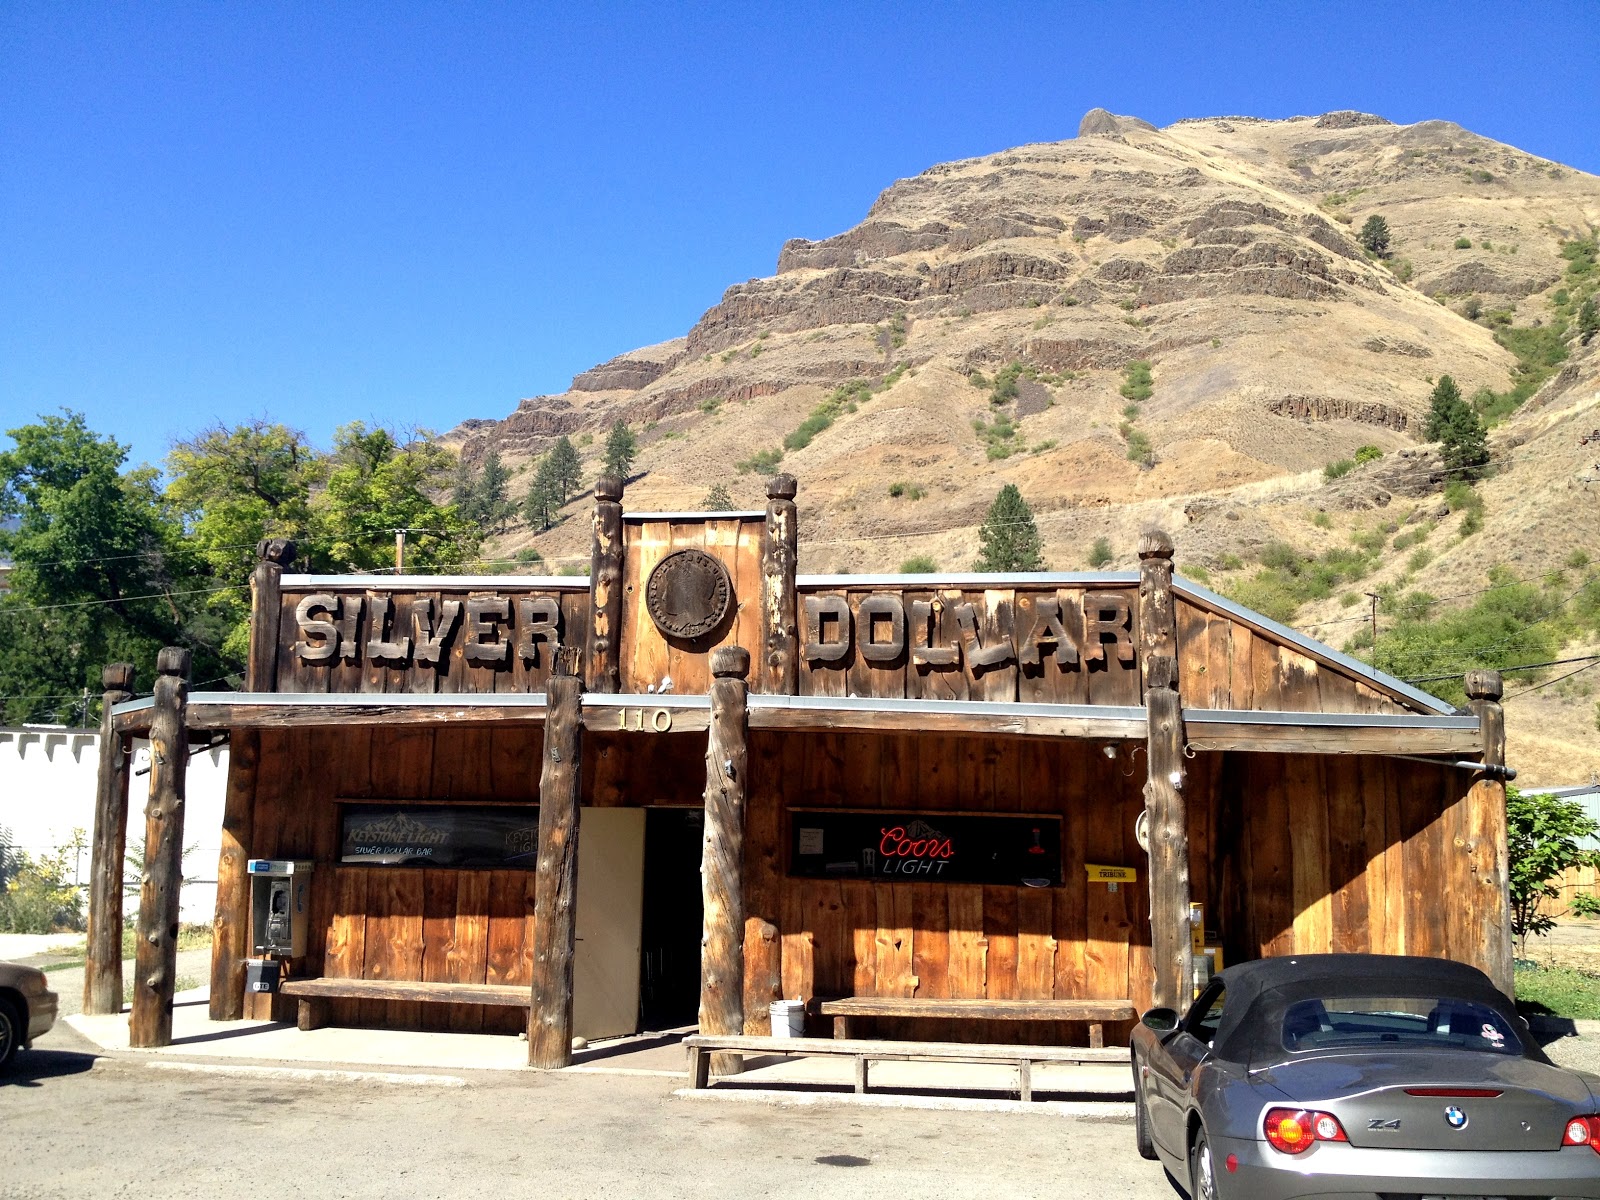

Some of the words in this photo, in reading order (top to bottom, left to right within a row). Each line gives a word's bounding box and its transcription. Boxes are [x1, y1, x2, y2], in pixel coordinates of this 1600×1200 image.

[296, 594, 561, 662] SILVER
[805, 594, 1134, 668] DOLLAR
[618, 707, 672, 732] 110
[348, 829, 406, 844] KEYSTONE
[407, 831, 449, 844] LIGHT
[505, 828, 539, 845] KEYSTO
[880, 827, 955, 857] Coors
[355, 846, 382, 855] SILVER
[383, 846, 414, 855] DOLLAR
[416, 847, 433, 856] BAR
[883, 860, 949, 874] LIGHT
[1367, 1118, 1401, 1129] Z4
